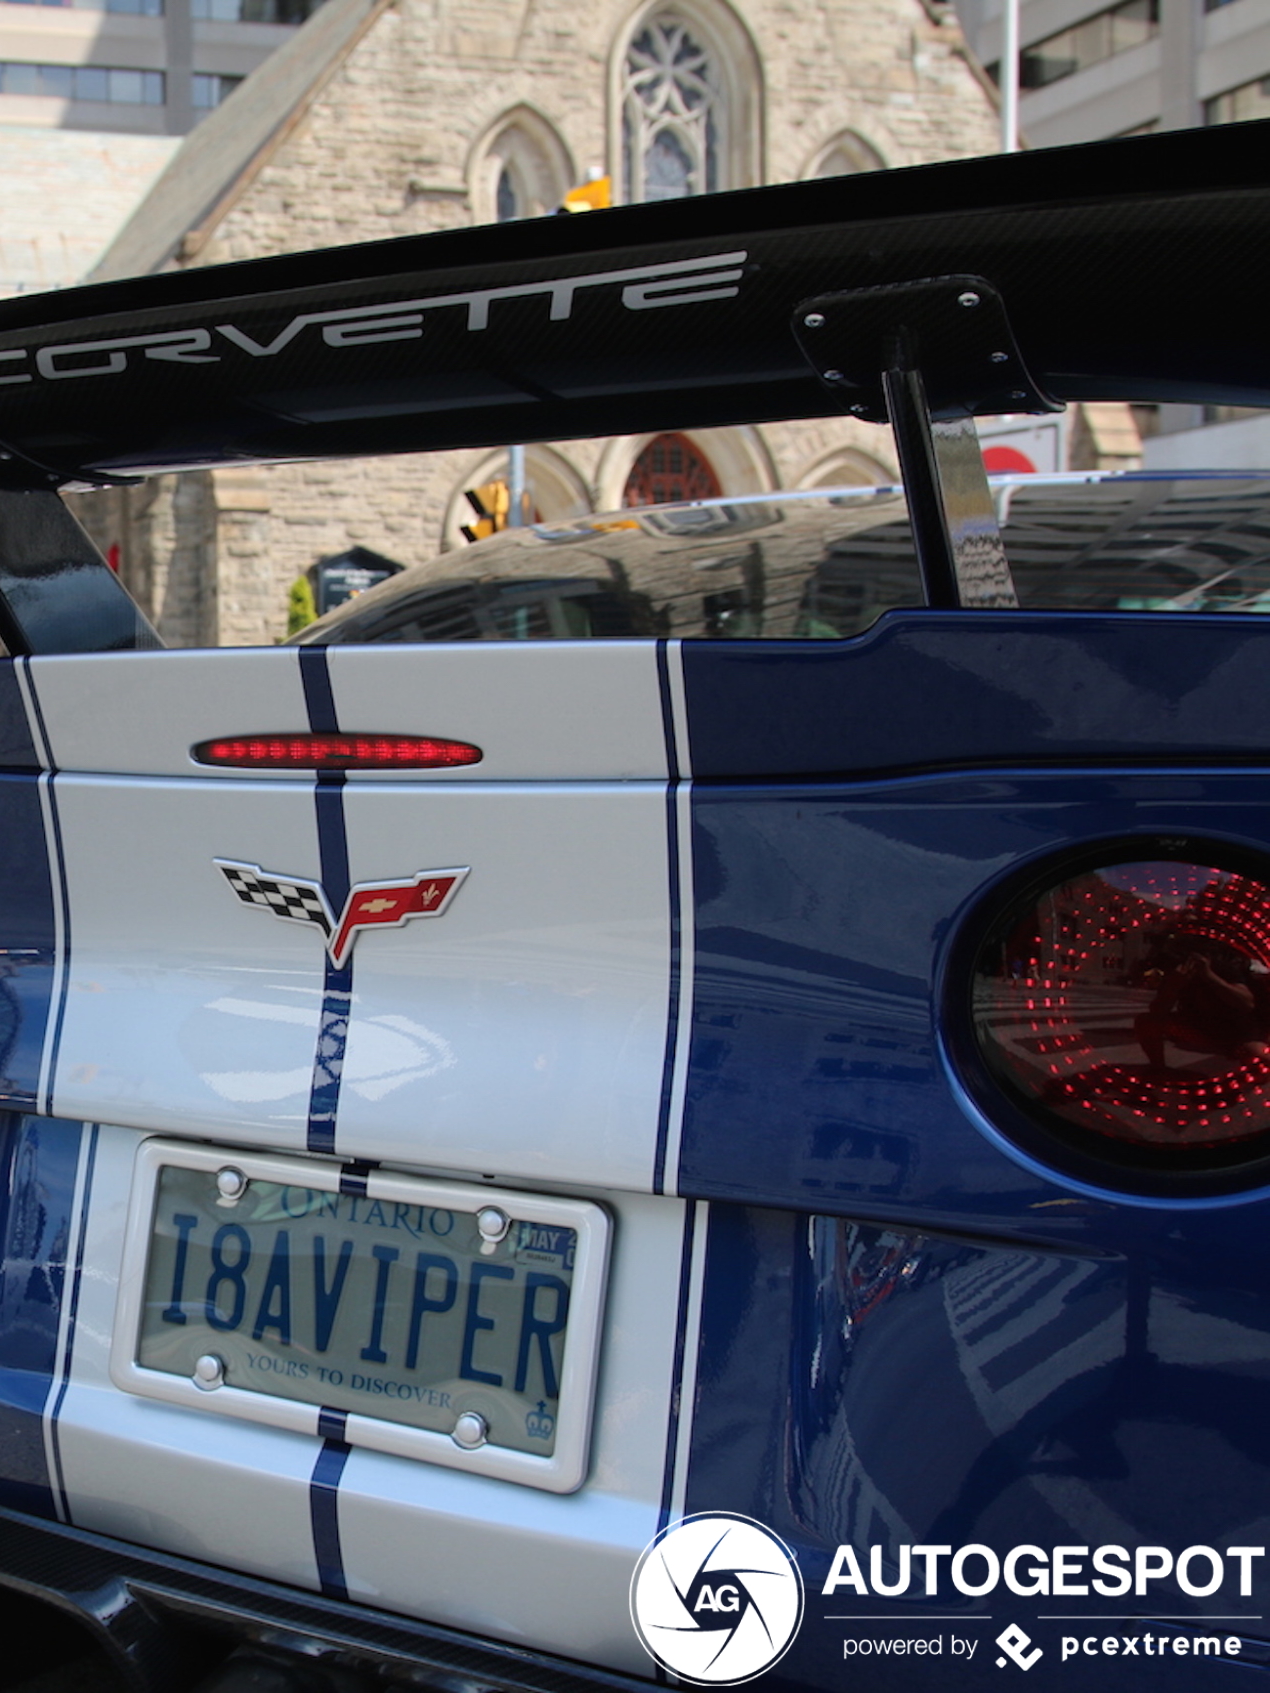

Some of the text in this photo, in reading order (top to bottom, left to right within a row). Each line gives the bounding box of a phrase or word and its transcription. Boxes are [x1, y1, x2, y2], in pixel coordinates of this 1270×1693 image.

[281, 1185, 454, 1240] ONTARIO
[521, 1228, 560, 1252] MAY
[162, 1213, 570, 1399] I8AVIPER
[246, 1353, 452, 1409] YOURS TO DISCOVER
